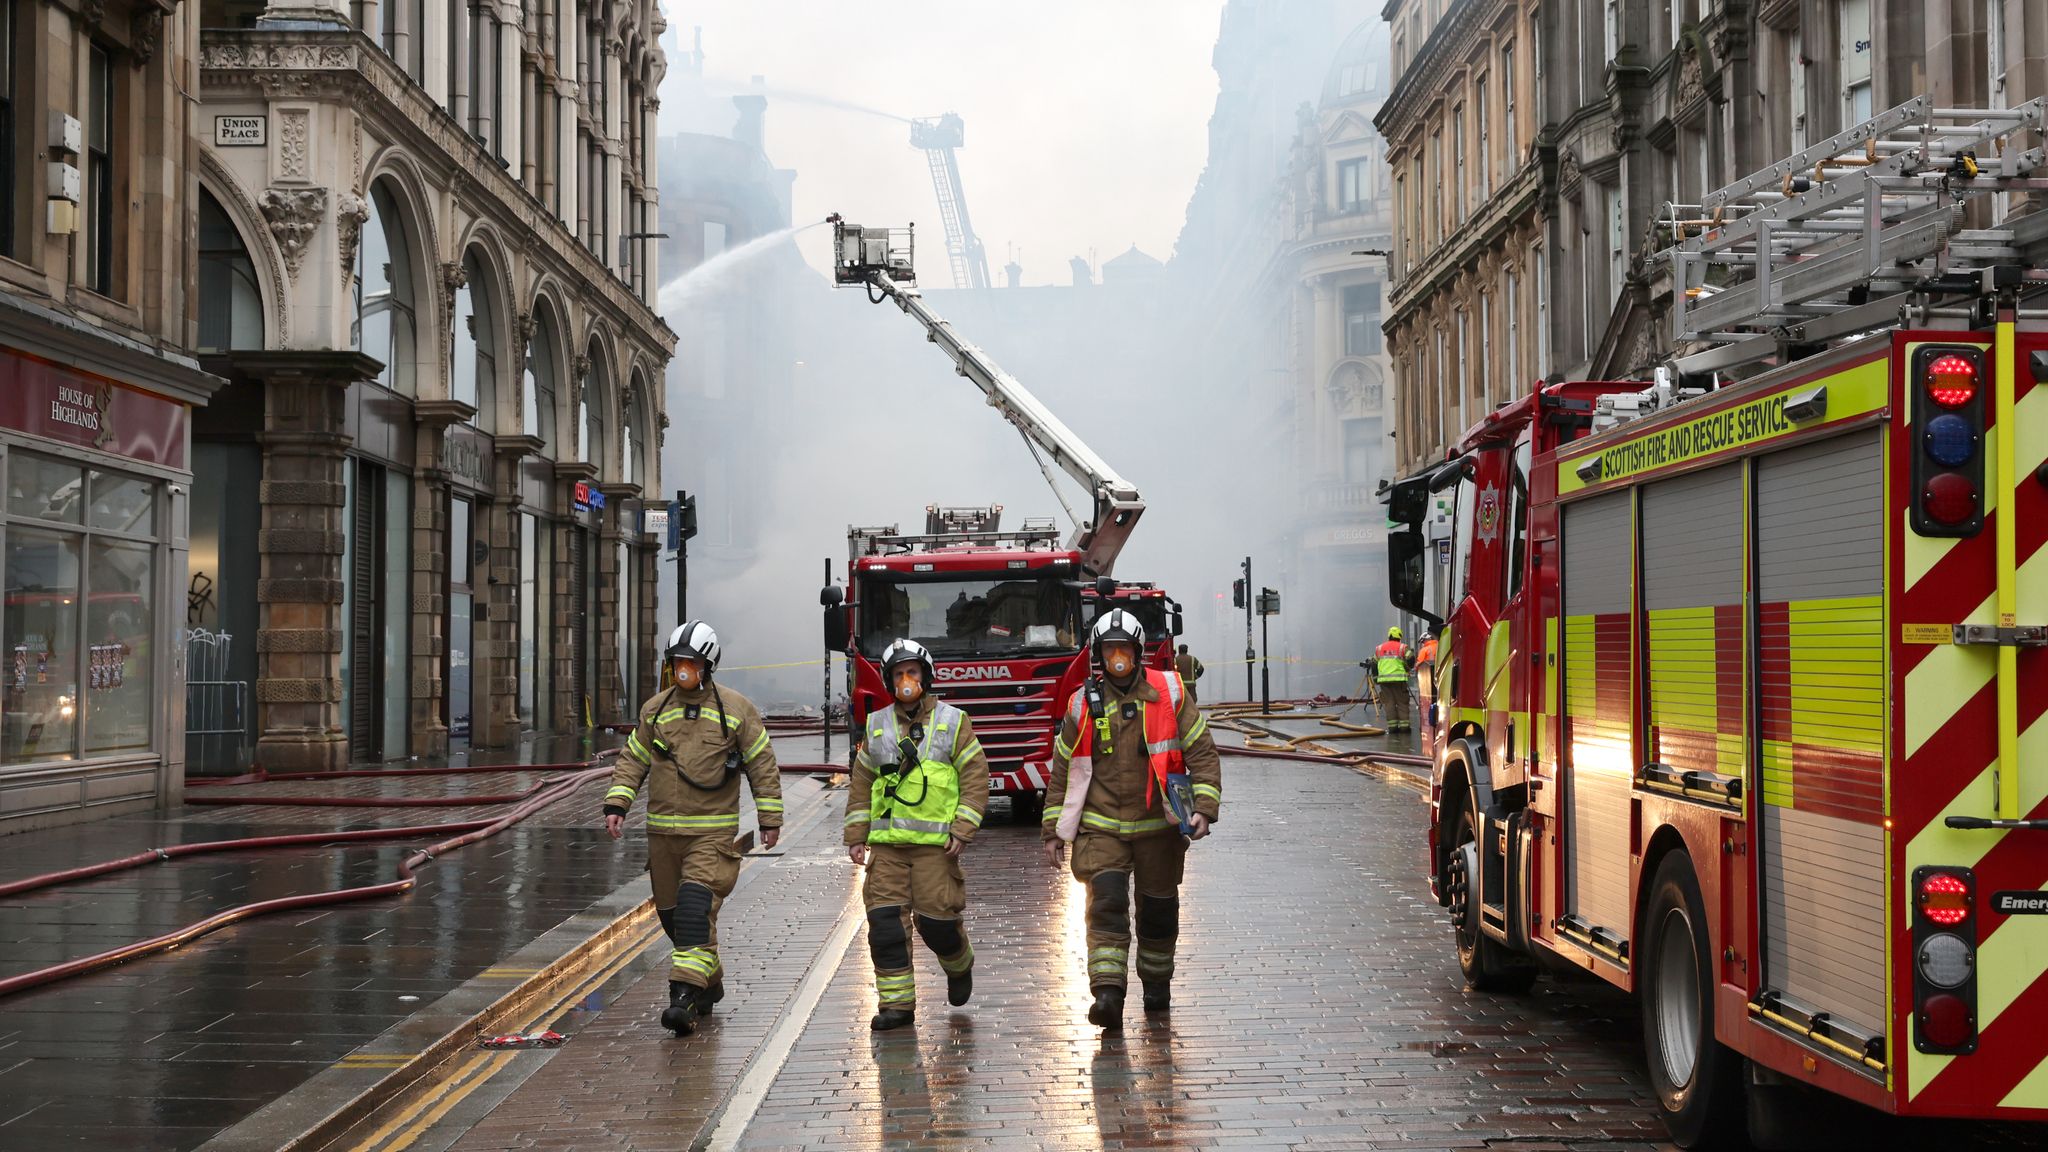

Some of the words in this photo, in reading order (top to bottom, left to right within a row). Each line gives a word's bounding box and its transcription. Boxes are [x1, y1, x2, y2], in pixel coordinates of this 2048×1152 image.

[58, 385, 82, 406] HOUSE
[83, 393, 94, 409] OF
[51, 400, 98, 430] HIGHLANDS
[1605, 440, 1645, 478] SCOTTISH
[1647, 433, 1666, 467] FIRE
[1668, 426, 1691, 461] AND
[1693, 412, 1734, 453] RESCUE
[1737, 394, 1789, 441] SERVICE
[1915, 626, 1939, 635] WARNING
[936, 665, 1012, 681] SCANIA
